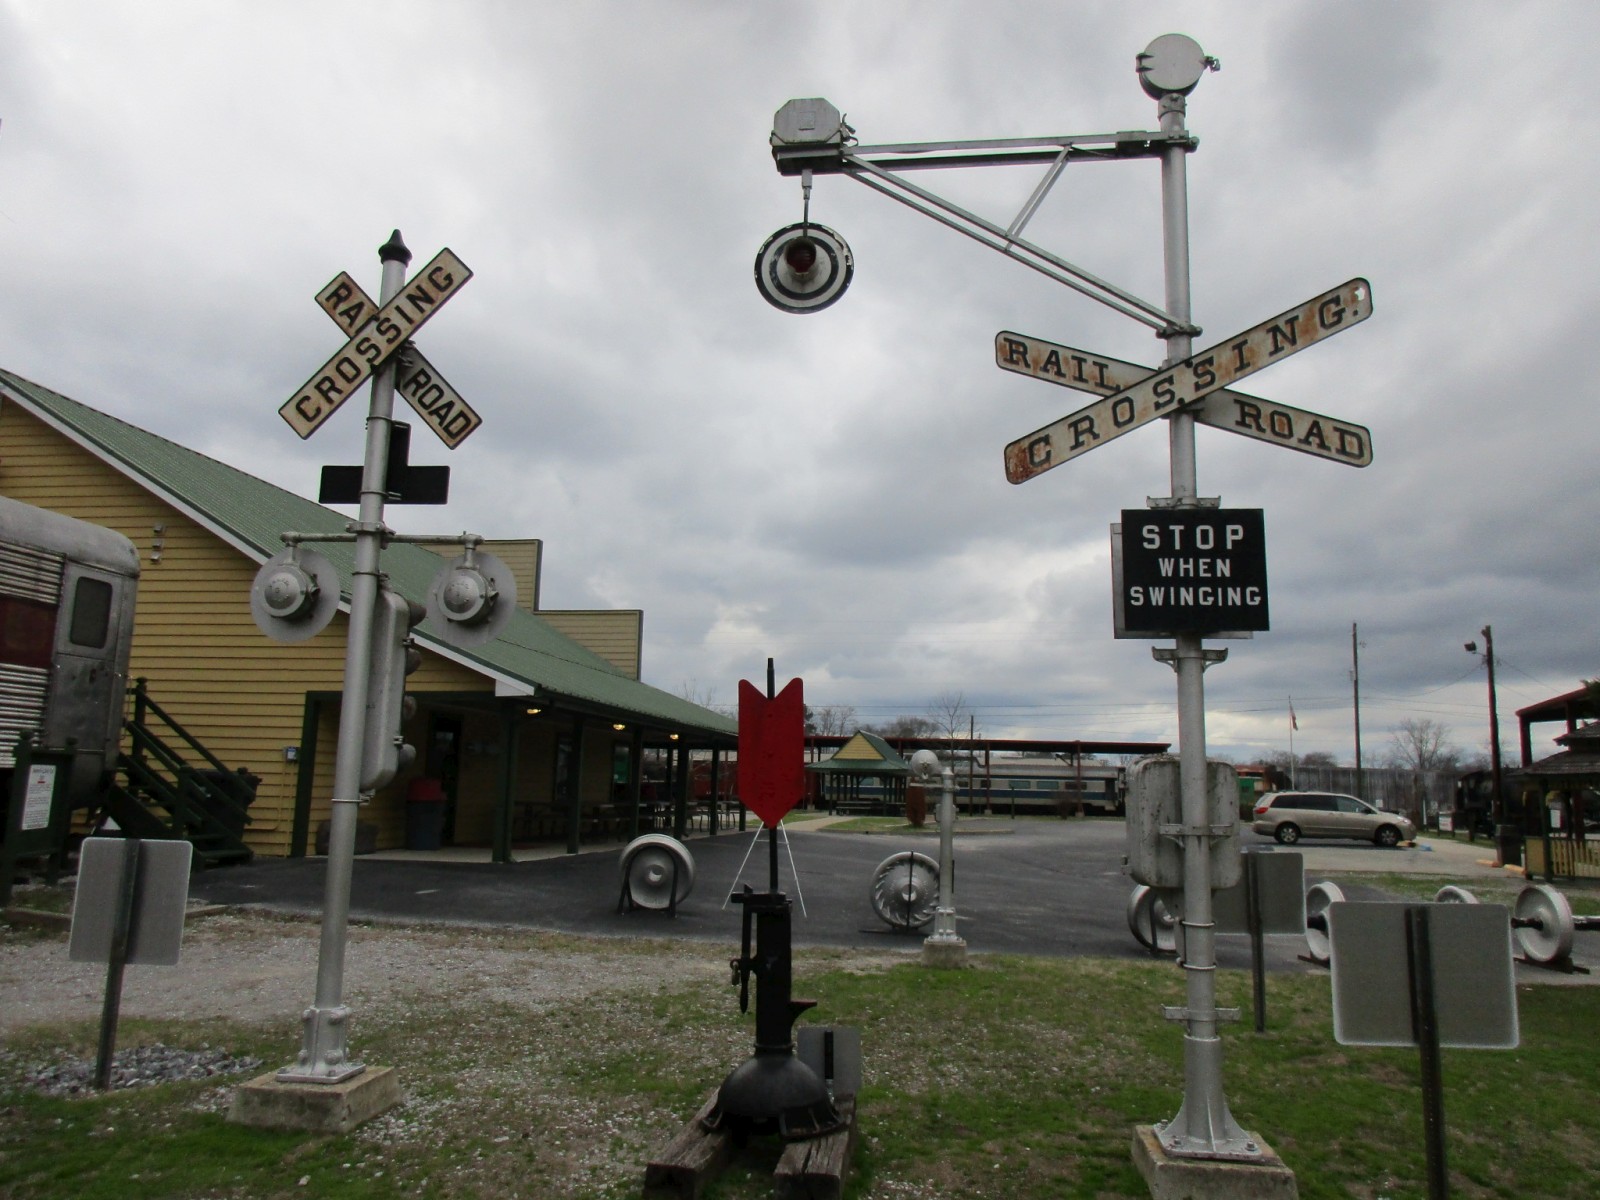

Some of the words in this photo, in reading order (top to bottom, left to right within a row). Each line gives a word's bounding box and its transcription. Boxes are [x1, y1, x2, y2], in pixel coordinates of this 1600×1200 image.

[295, 266, 454, 423] CROSSING
[325, 282, 379, 336] RAI
[402, 368, 473, 440] ROAD
[1003, 336, 1121, 393] RAIL
[1233, 398, 1365, 459] ROAD
[1142, 524, 1244, 550] STOP
[1158, 557, 1232, 578] WHEN
[1129, 586, 1262, 607] SWINGING
